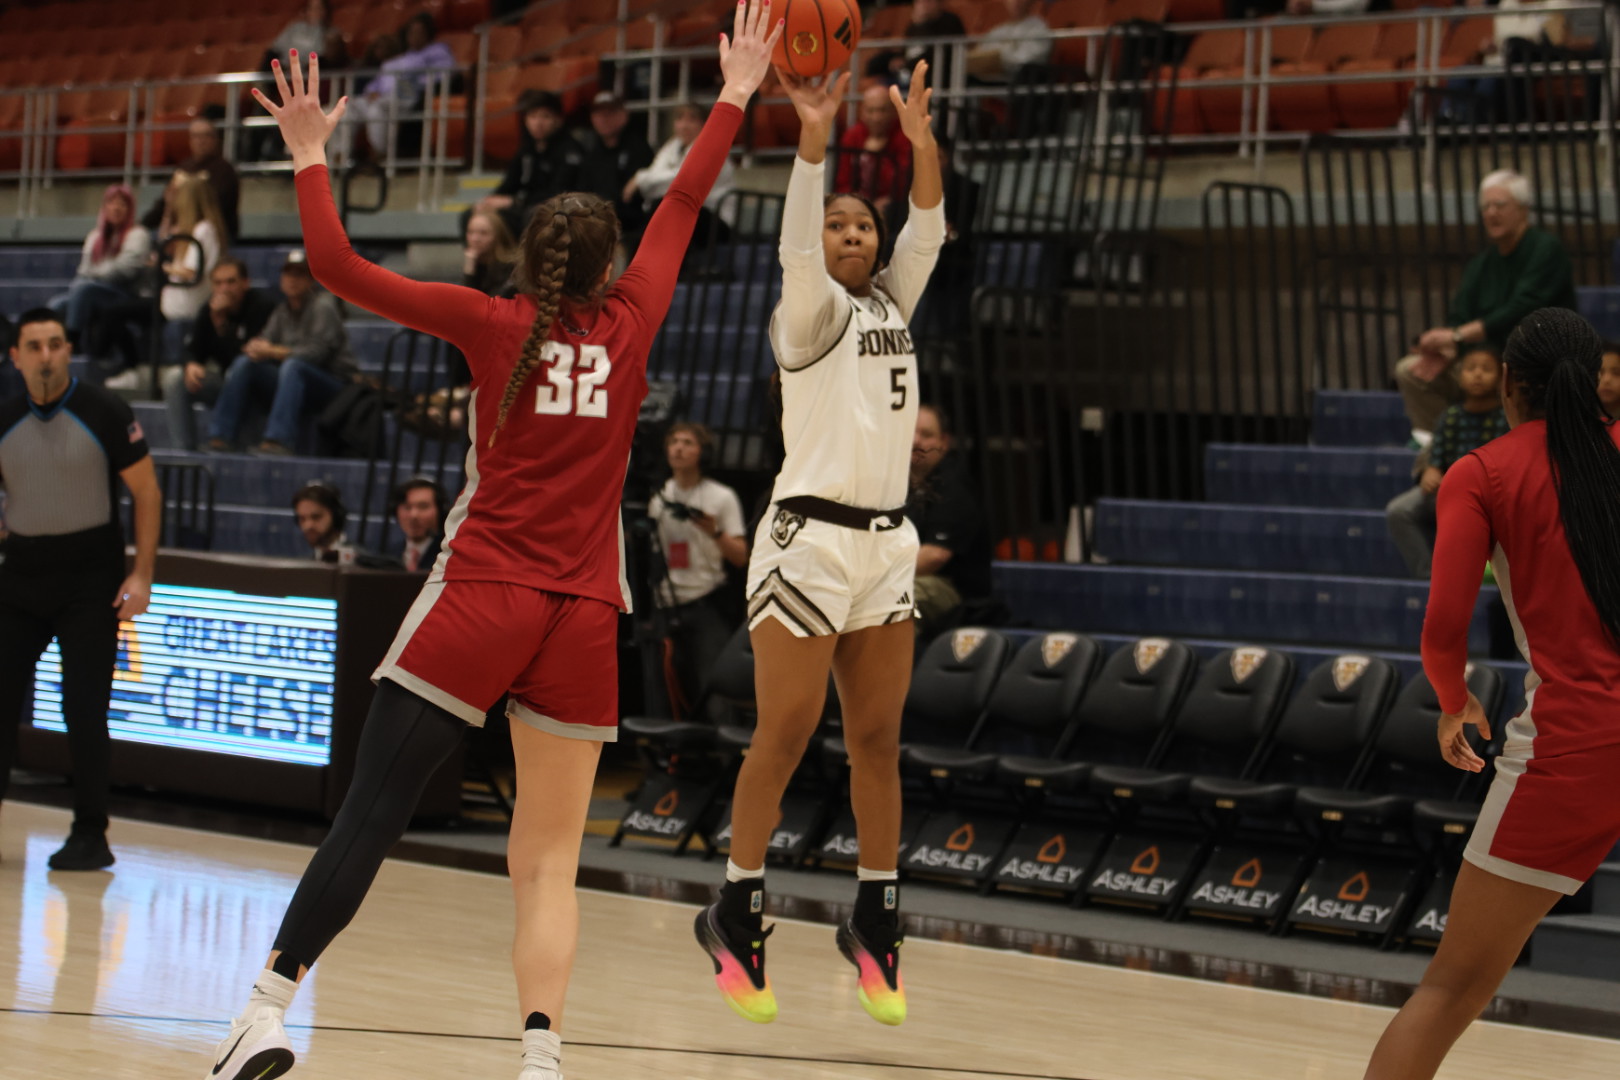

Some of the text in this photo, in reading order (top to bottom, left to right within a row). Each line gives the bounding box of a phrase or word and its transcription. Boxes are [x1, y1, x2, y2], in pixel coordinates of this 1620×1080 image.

[534, 340, 612, 418] 32
[890, 367, 908, 411] 5
[163, 665, 331, 744] CHEESE
[623, 810, 688, 835] ASHLEY
[908, 844, 993, 872] ASHLEY
[999, 857, 1084, 885] ASHLEY
[1092, 868, 1179, 897] ASHLEY
[1192, 881, 1282, 910] ASHLEY
[1297, 894, 1394, 925] ASHLEY
